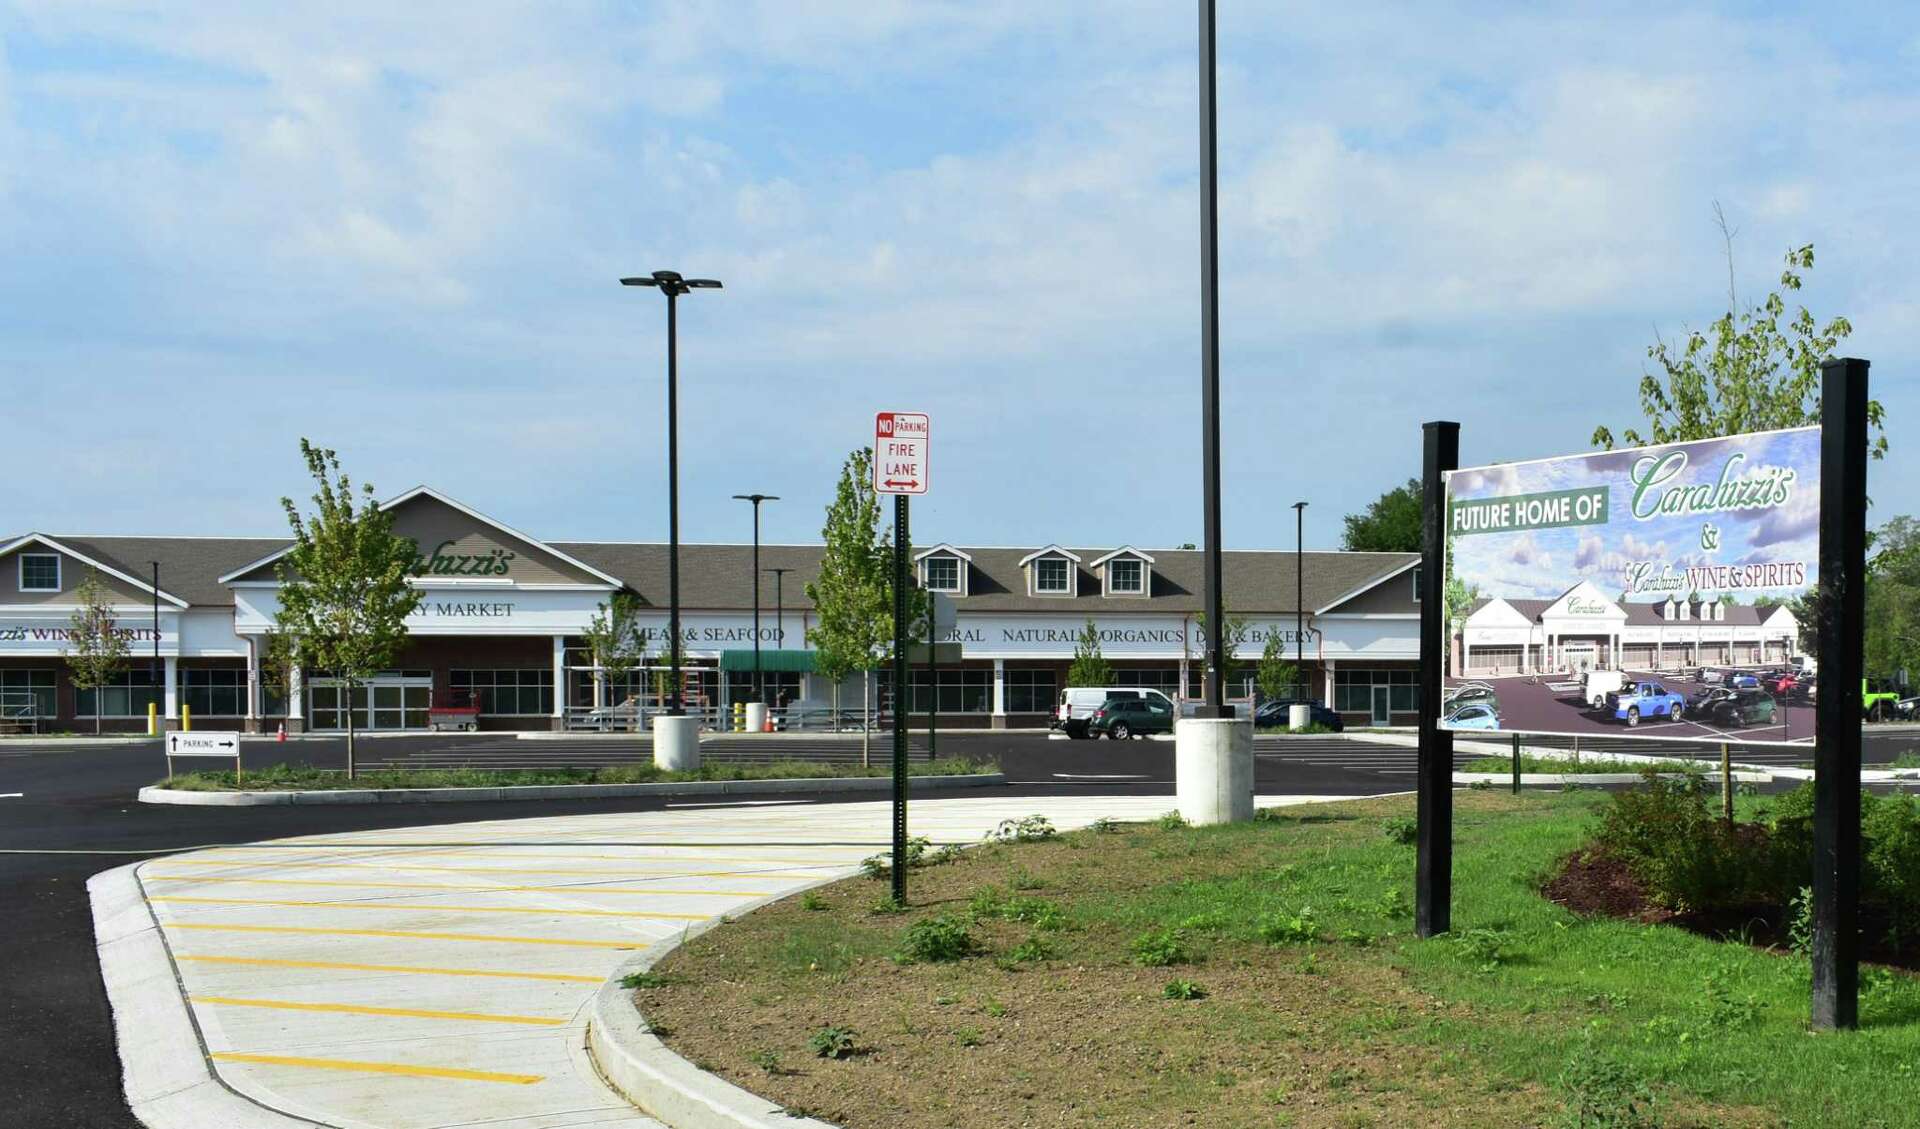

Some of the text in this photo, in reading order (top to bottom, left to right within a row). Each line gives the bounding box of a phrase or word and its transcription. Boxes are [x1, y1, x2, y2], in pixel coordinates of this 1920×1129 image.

[879, 420, 927, 433] NO PARKING
[889, 443, 915, 457] FIRE
[886, 463, 917, 476] LANE
[1631, 451, 1794, 518] Caraluzzi's
[1453, 494, 1602, 531] FUTURE HOME OF
[1701, 523, 1718, 550] &
[437, 603, 515, 616] MARKET
[32, 628, 80, 640] WIN
[686, 627, 698, 640] &
[704, 628, 784, 641] SEAFOOD
[1002, 629, 1080, 642] NATURAL
[1101, 629, 1184, 642] ORGANICS
[183, 739, 214, 748] PARKING
